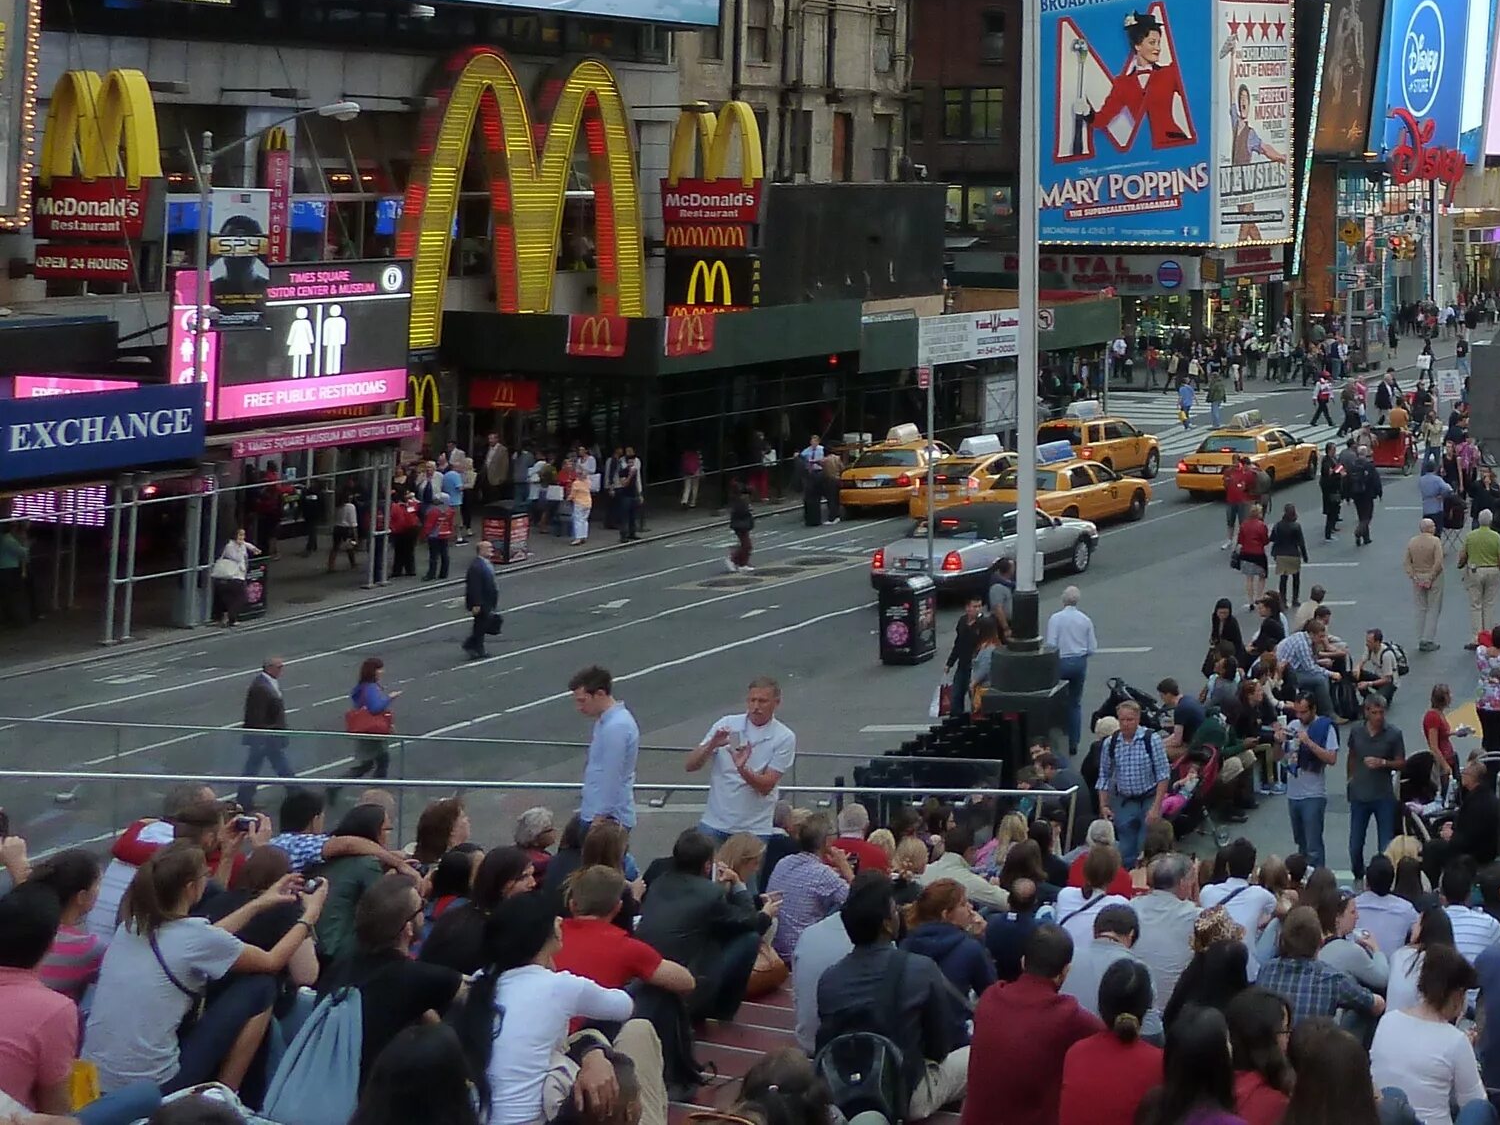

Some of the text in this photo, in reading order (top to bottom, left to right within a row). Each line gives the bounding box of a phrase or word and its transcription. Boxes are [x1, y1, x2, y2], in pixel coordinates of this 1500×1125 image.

[1408, 32, 1439, 88] Disney
[1255, 104, 1286, 120] MUSICAL
[1039, 176, 1103, 209] MARY
[1109, 162, 1209, 200] POPPINS
[1220, 163, 1286, 194] NEWSIES
[37, 197, 139, 217] McDonald's
[666, 193, 754, 206] McDonald's
[680, 209, 738, 218] Restaurant
[51, 220, 120, 231] Restaurant
[219, 239, 261, 254] SPY
[36, 257, 128, 270] OPEN 24 HOURS
[290, 272, 350, 283] TIMES SQUARE
[297, 285, 330, 296] CENTER
[338, 283, 375, 293] MUSEUM
[243, 380, 387, 407] FREE PUBLIC RESTROOMS
[9, 408, 192, 452] EXCHANGE
[248, 424, 414, 451] TIMES SQUARE MUSEUM AND VISITOR CENTER
